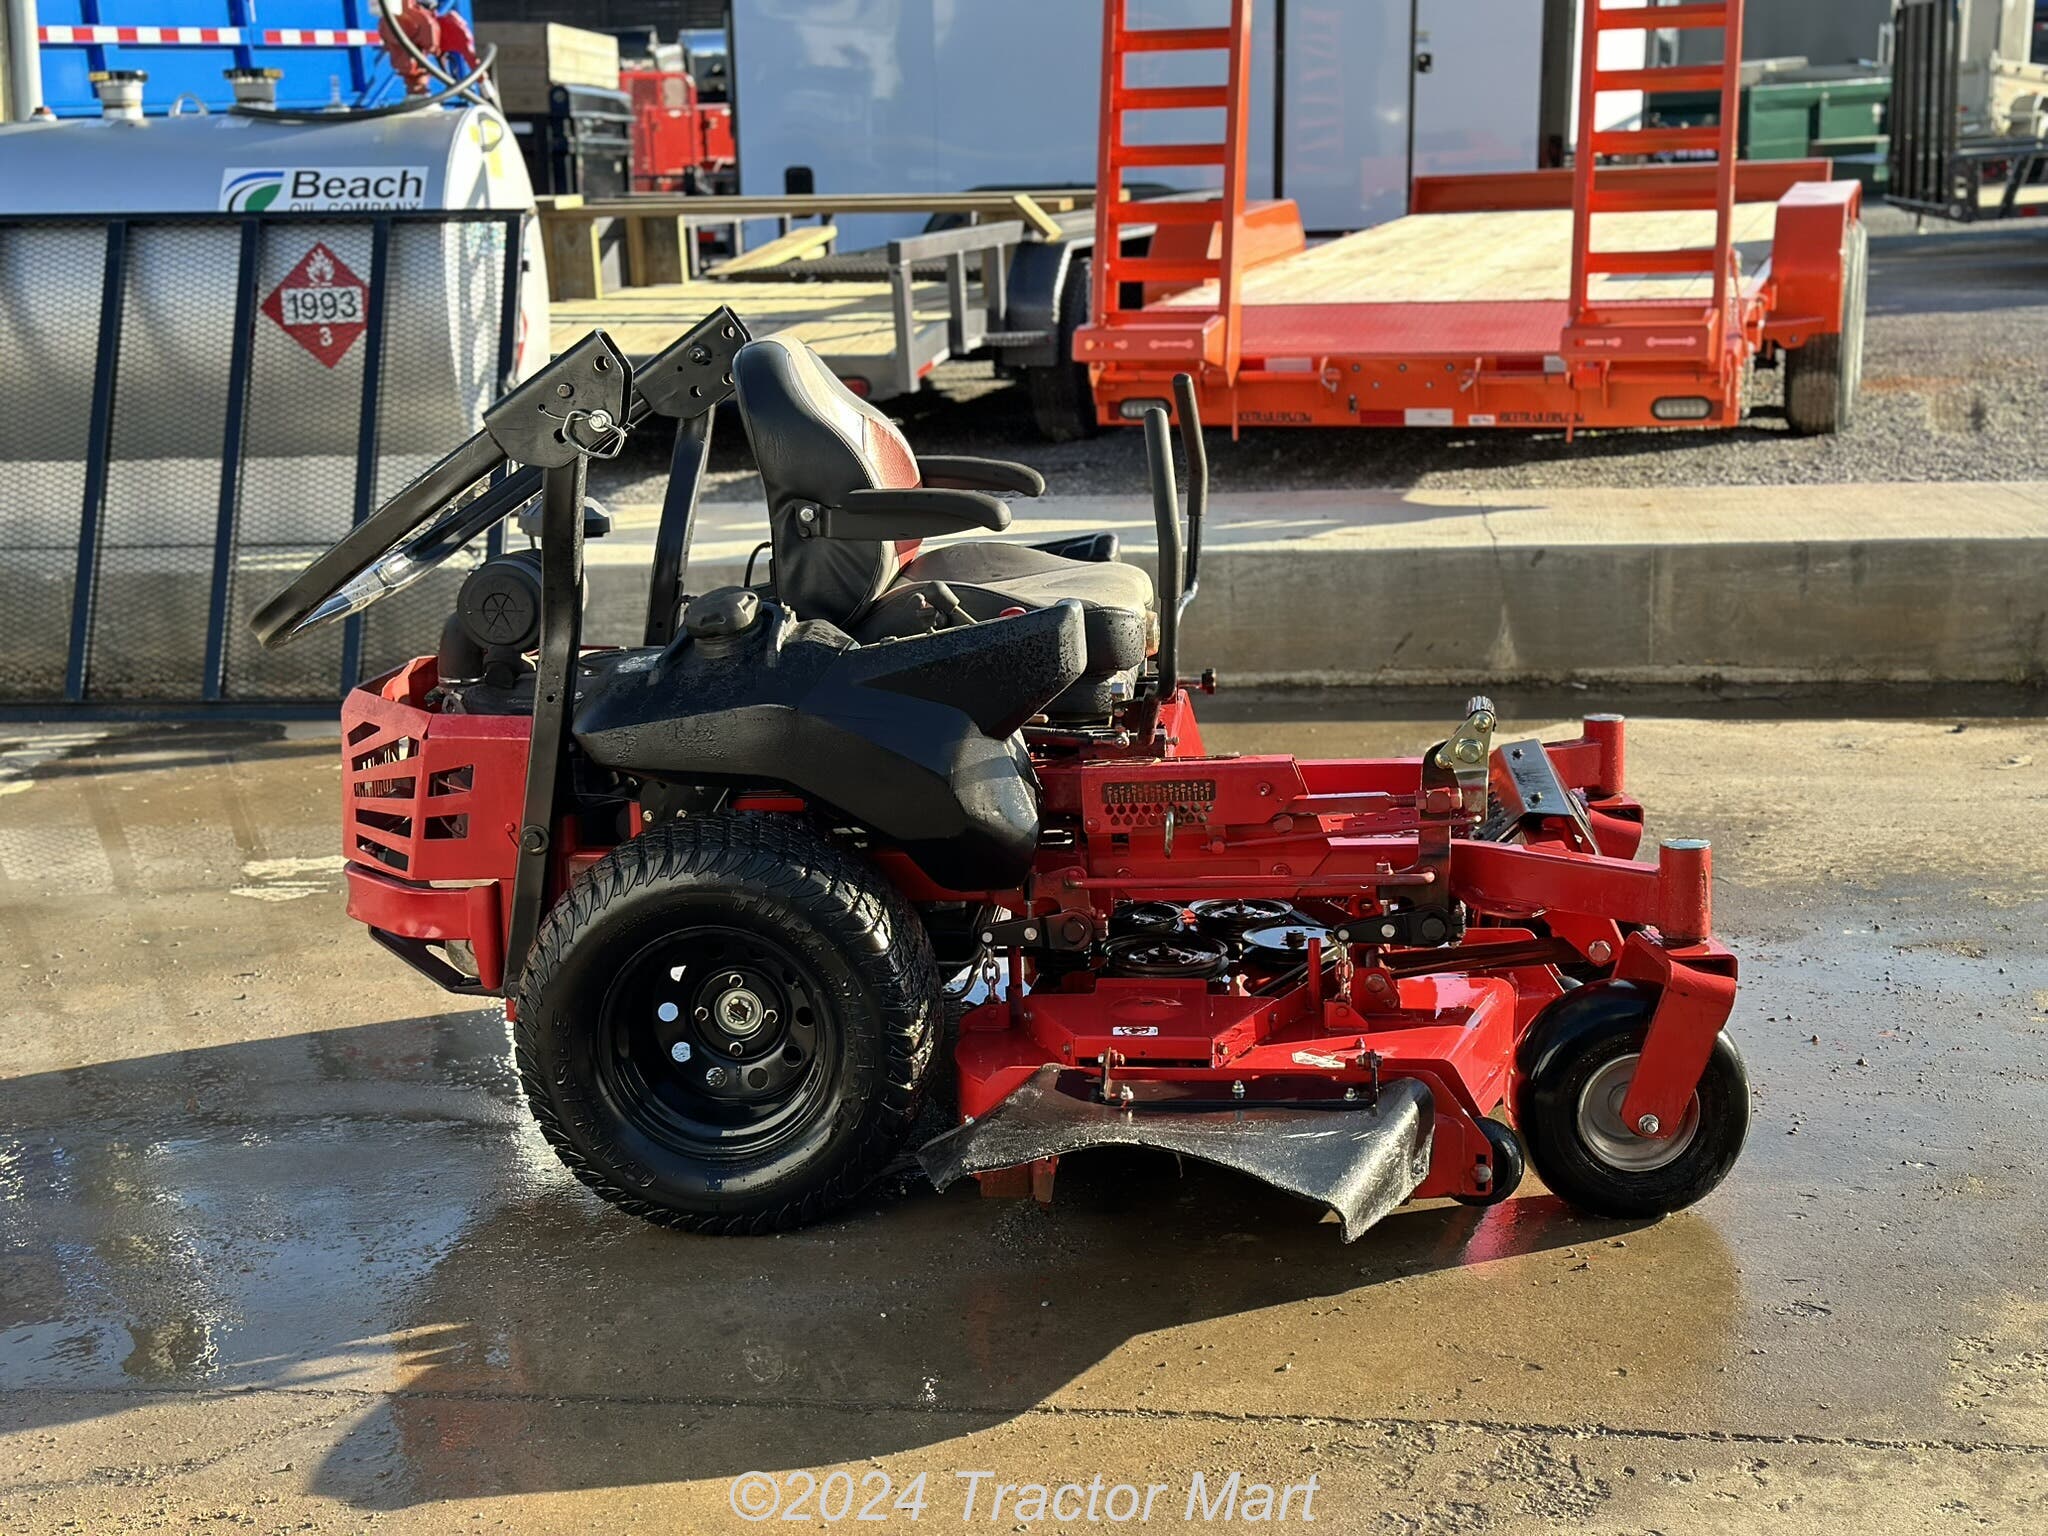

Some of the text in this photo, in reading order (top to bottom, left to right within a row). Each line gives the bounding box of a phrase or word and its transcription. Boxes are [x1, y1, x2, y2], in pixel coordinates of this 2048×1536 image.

[291, 169, 423, 199] Beach
[288, 290, 357, 320] 1993
[320, 326, 333, 347] 3
